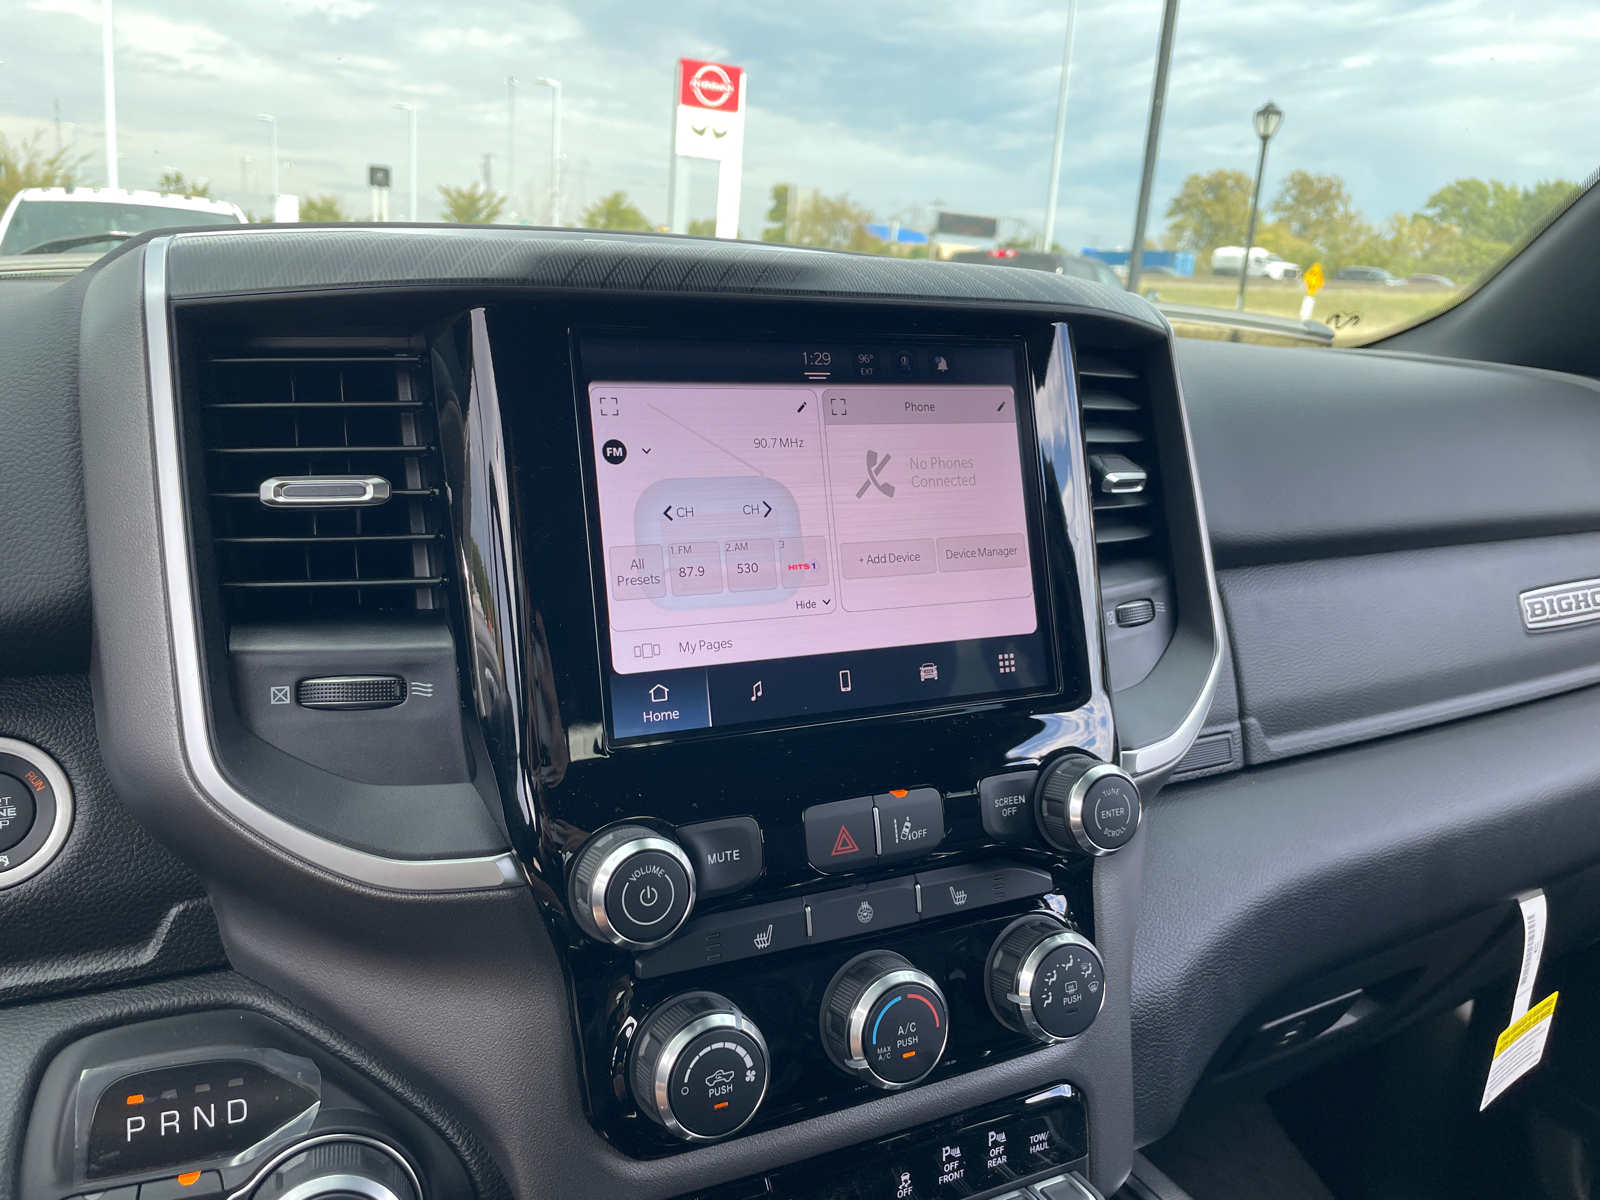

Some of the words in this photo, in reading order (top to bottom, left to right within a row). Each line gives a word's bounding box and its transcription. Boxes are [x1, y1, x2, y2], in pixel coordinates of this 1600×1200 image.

[803, 352, 831, 366] 1:29
[859, 355, 874, 364] 96°
[861, 368, 873, 376] EXT
[905, 402, 936, 412] Phone
[754, 438, 777, 449] 90.7
[780, 438, 804, 448] MHz
[606, 447, 623, 457] FM
[910, 458, 928, 470] No
[931, 457, 974, 470] Phones
[911, 474, 977, 488] Connected
[676, 507, 694, 518] CH
[743, 505, 760, 515] CH
[671, 546, 693, 555] 1.FM
[726, 542, 749, 552] 2.AM
[780, 541, 786, 549] 3
[866, 553, 887, 565] Add
[889, 552, 921, 564] Device
[946, 548, 977, 560] Device
[978, 547, 1018, 558] Manager
[631, 559, 645, 570] All
[737, 563, 759, 574] 530
[679, 566, 705, 578] 87.9
[617, 575, 661, 586] Presets
[796, 600, 817, 610] Hide
[679, 642, 697, 654] My
[699, 639, 733, 653] Pages
[643, 710, 680, 723] Home
[25, 771, 45, 792] RUN
[1103, 787, 1120, 797] TUNE
[995, 795, 1026, 808] SCREEN
[1002, 807, 1018, 817] OFF
[1102, 808, 1125, 819] ENTER
[912, 828, 928, 841] OFF
[1103, 826, 1126, 838] SCROLL
[708, 850, 741, 865] MUTE
[629, 865, 665, 881] VOLUME
[1063, 994, 1082, 1006] PUSH
[898, 1022, 917, 1036] A/C
[897, 1036, 919, 1048] PUSH
[877, 1046, 891, 1054] MAX
[879, 1053, 891, 1061] A/C
[709, 1084, 733, 1098] PUSH
[127, 1116, 145, 1142] P
[161, 1111, 180, 1136] R
[194, 1103, 215, 1130] N
[228, 1099, 248, 1124] D
[1030, 1131, 1050, 1144] TOW/
[990, 1146, 1005, 1158] OFF
[1030, 1142, 1050, 1154] HAUL
[944, 1161, 960, 1172] OFF
[988, 1156, 1007, 1168] REAR
[939, 1169, 965, 1185] FRONT
[897, 1187, 913, 1199] OFF
